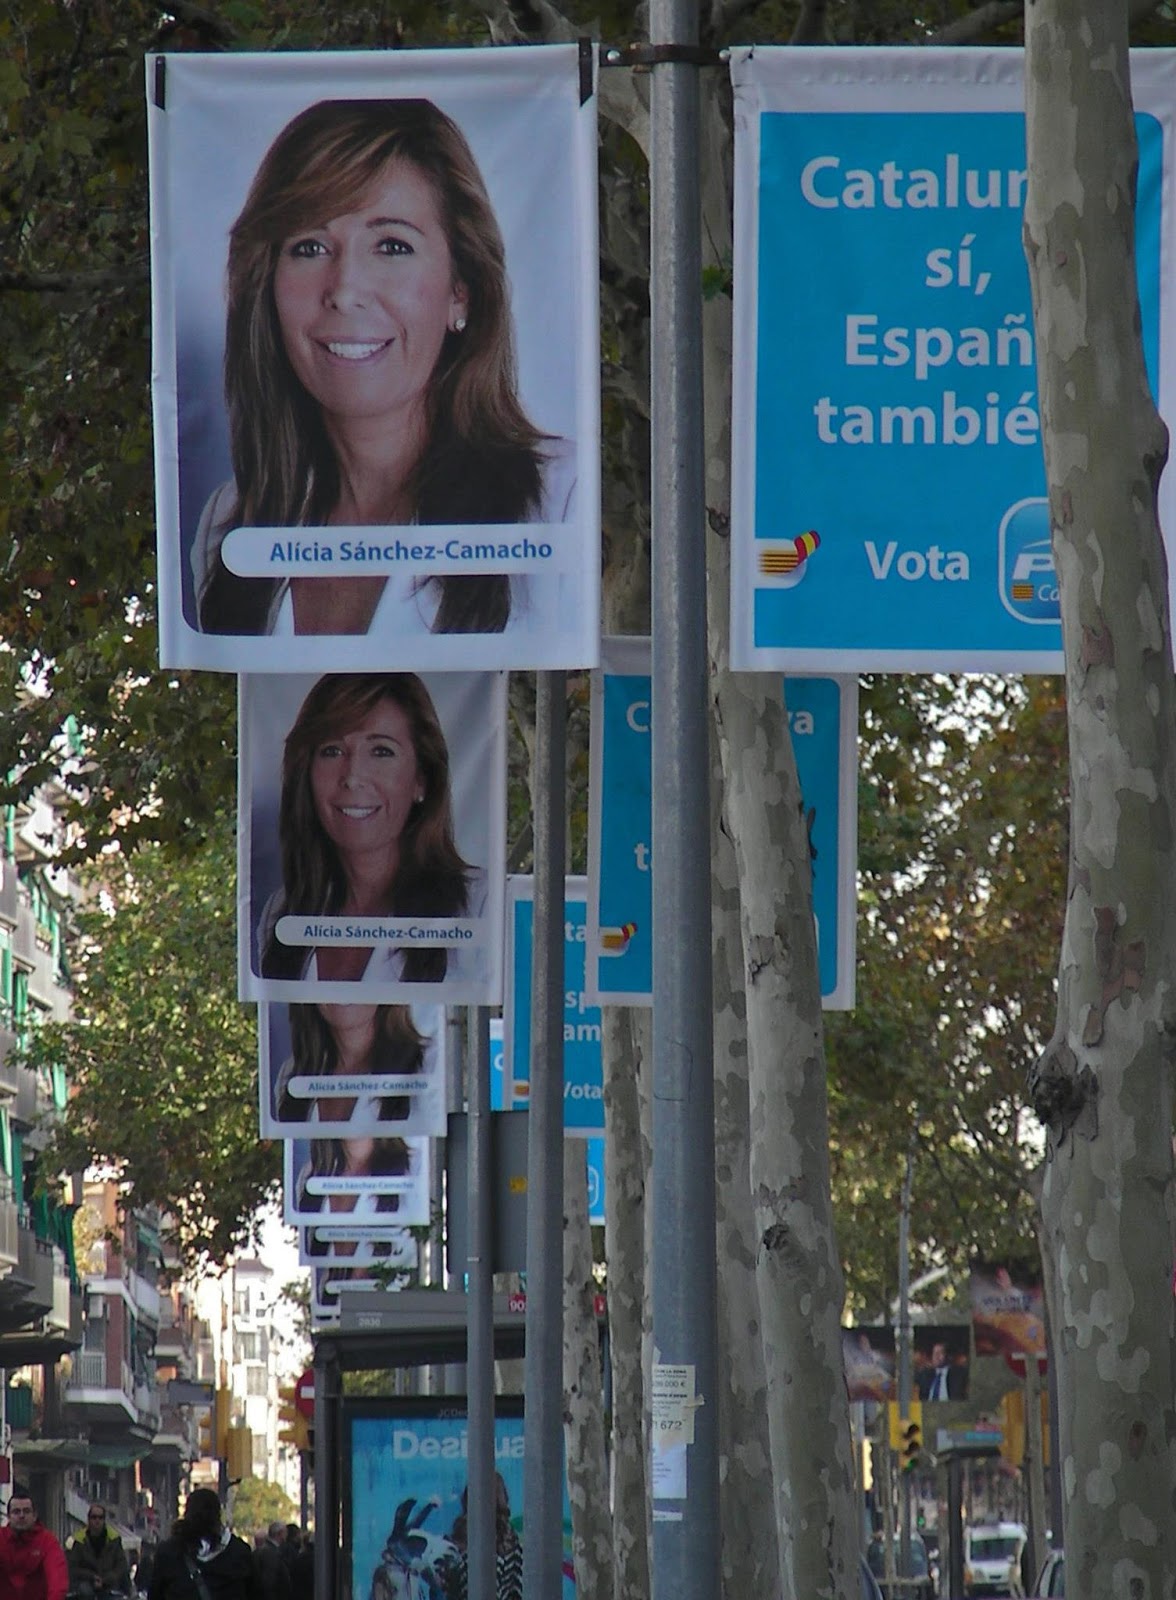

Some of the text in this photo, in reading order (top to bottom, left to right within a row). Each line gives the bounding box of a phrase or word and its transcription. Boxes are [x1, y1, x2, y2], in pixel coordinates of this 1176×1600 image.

[925, 233, 992, 295] sí,
[845, 313, 1033, 380] Españ
[813, 390, 1040, 445] tambié
[270, 538, 553, 562] Alícia Sánchez-Camacho
[864, 540, 970, 581] Vota
[303, 924, 473, 939] Alícia Sánchez-Camacho
